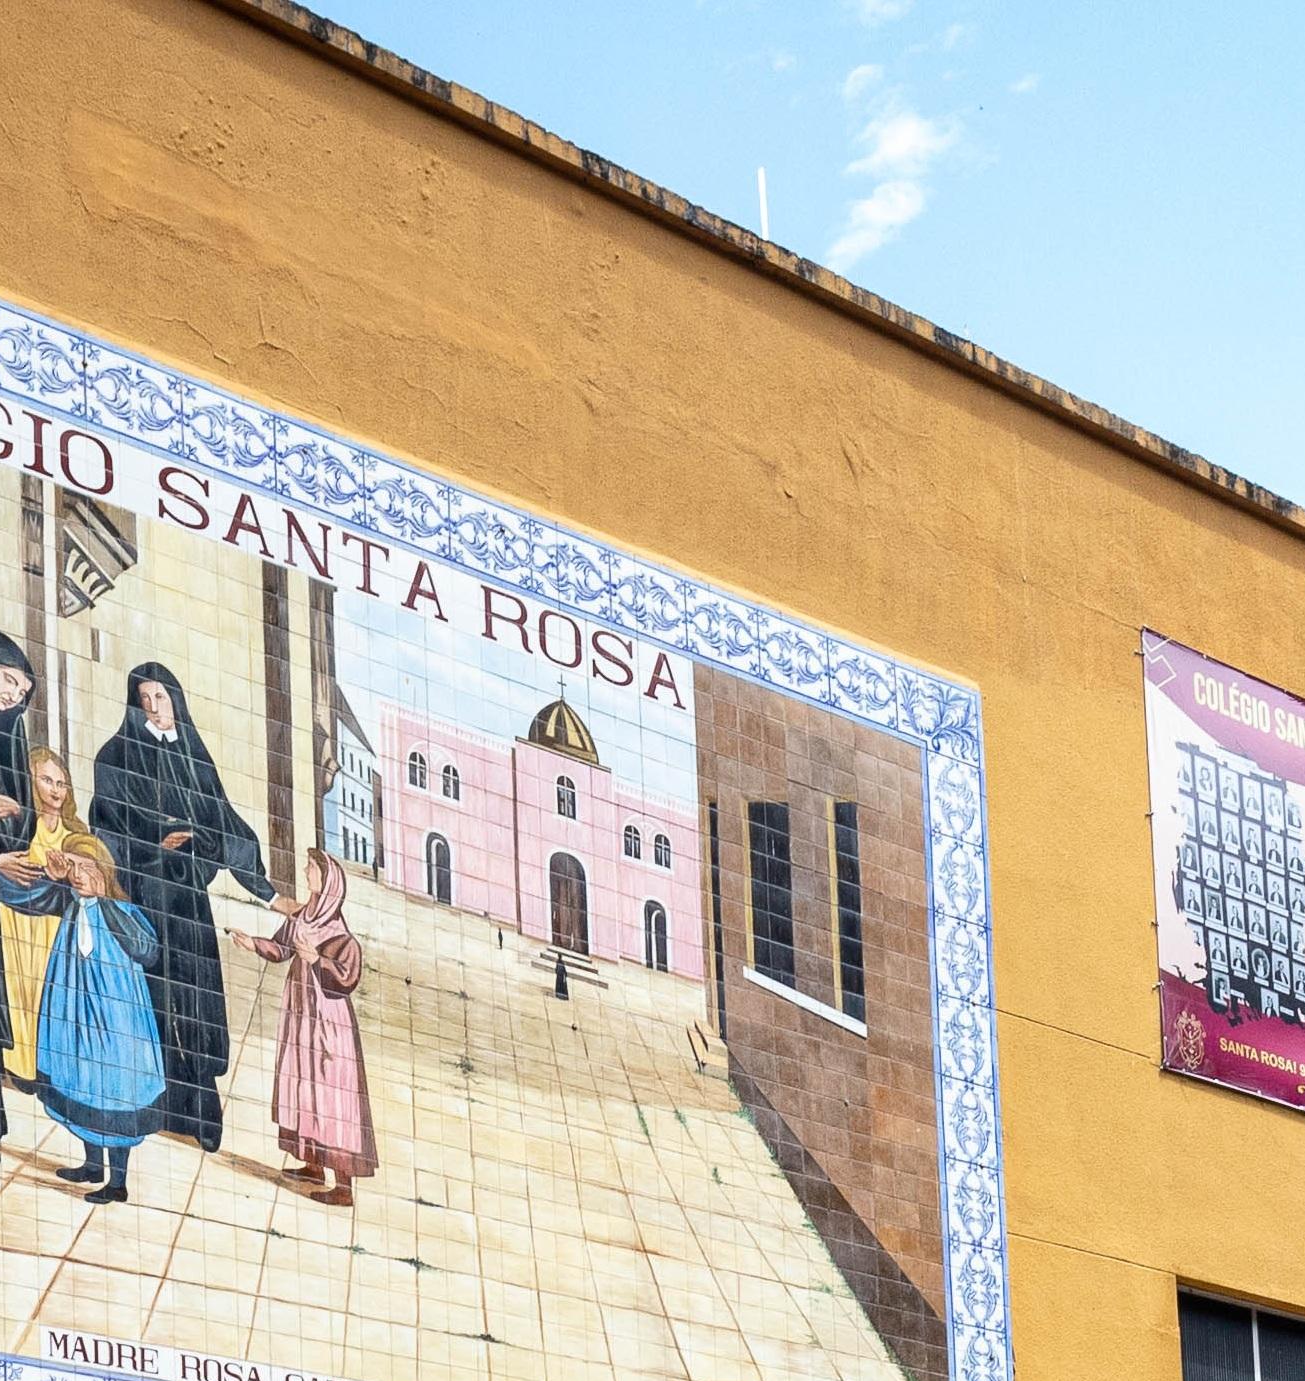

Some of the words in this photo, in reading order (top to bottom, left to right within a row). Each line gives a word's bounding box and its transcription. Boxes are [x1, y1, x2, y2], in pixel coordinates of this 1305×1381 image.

[156, 466, 447, 622] SANTA
[481, 583, 689, 711] ROSA
[1193, 671, 1270, 734] COLÉGIO
[1219, 1037, 1259, 1064] SANTA
[1260, 1049, 1297, 1074] ROSA!
[48, 1330, 159, 1375] MADRE
